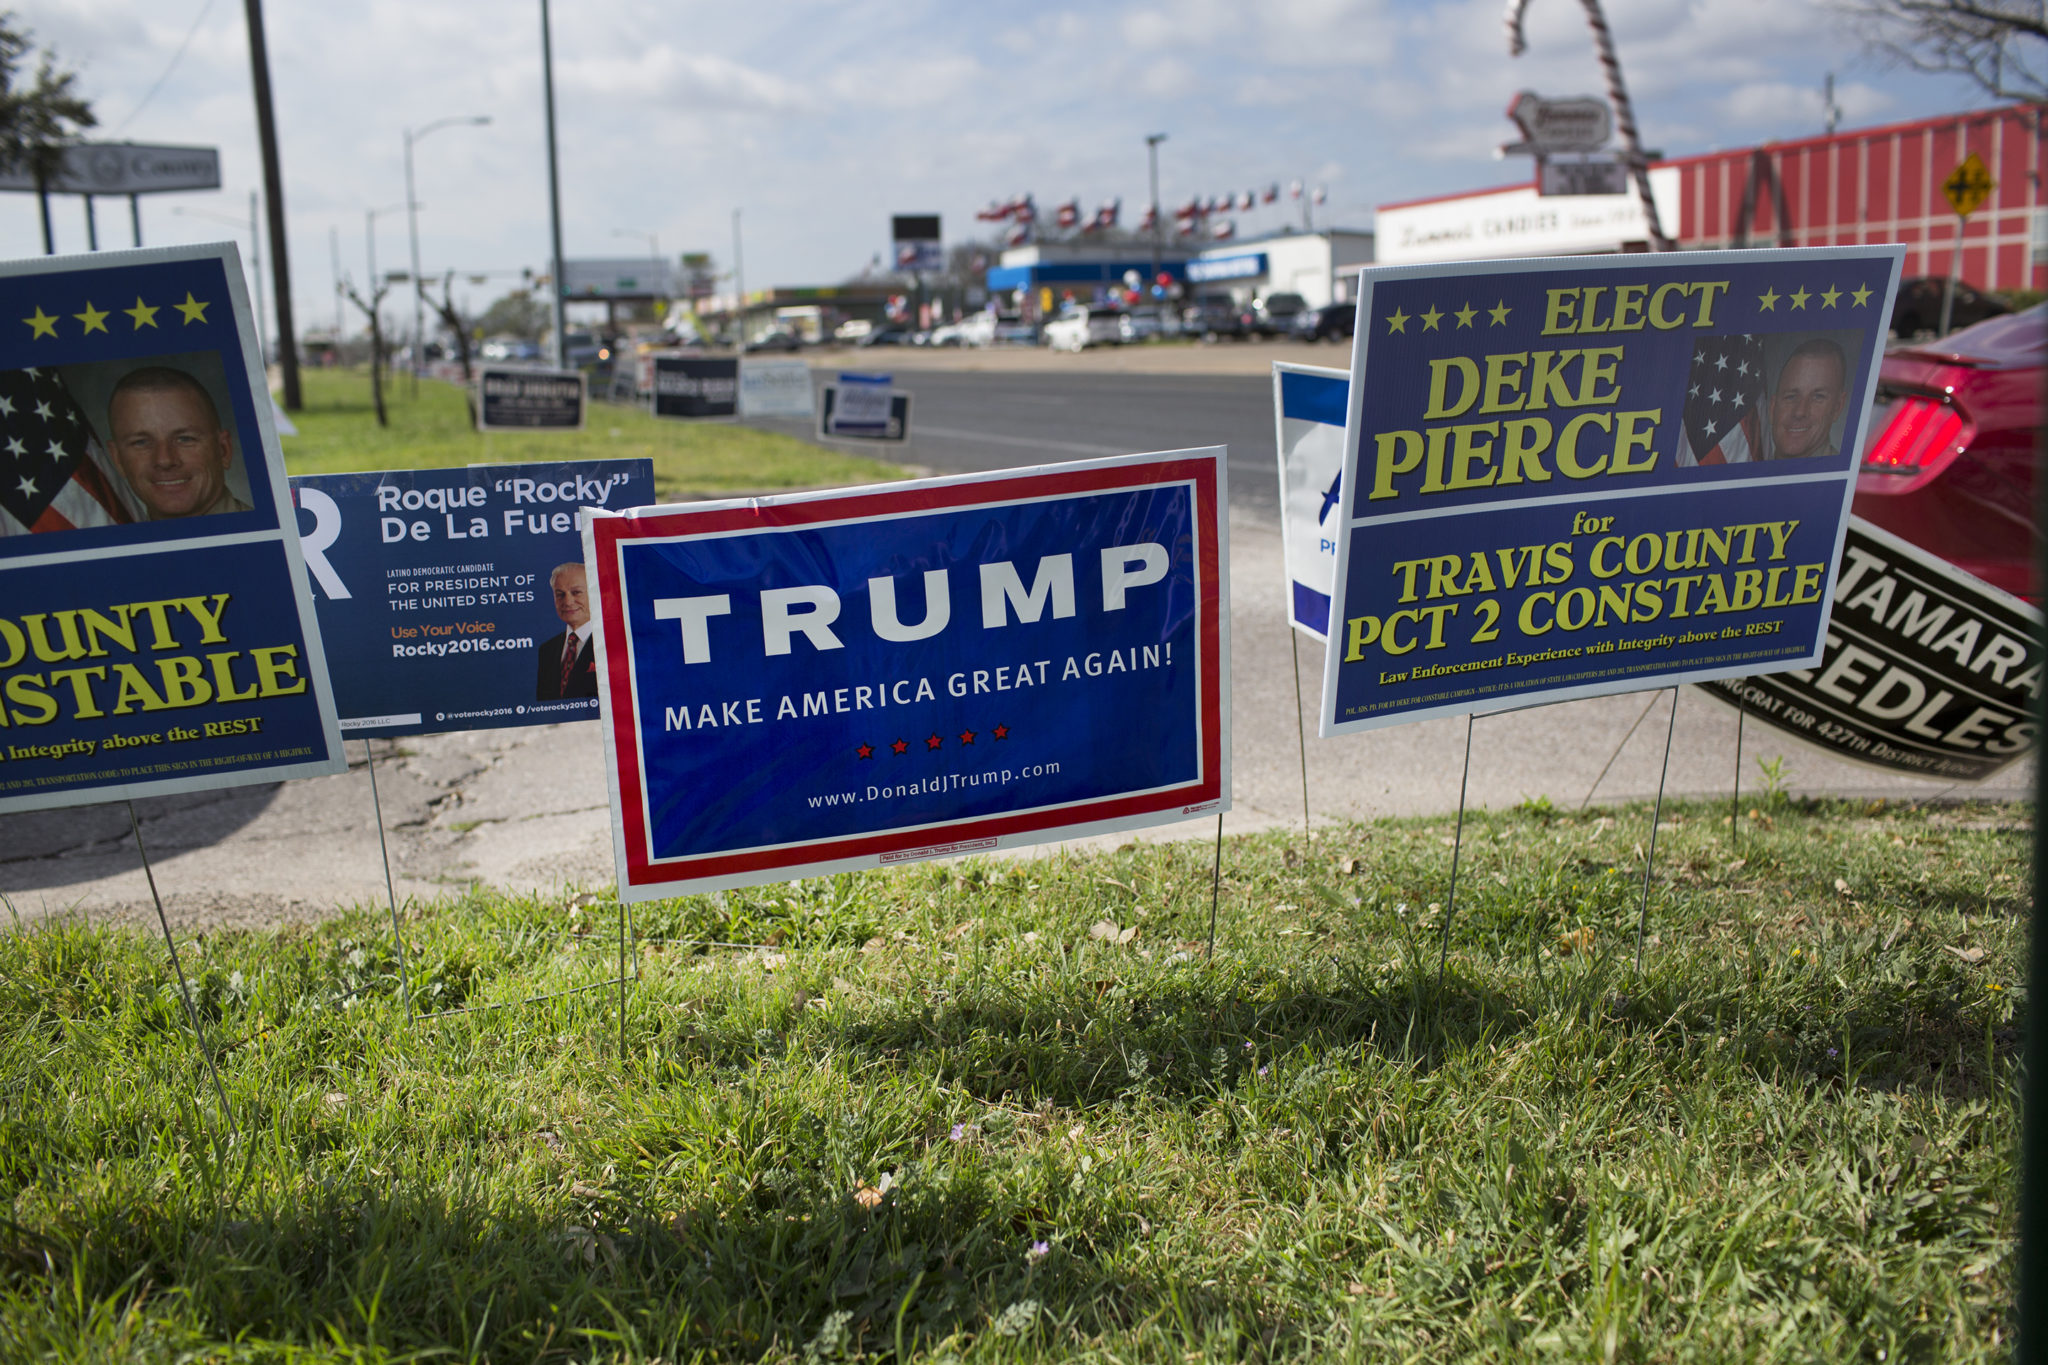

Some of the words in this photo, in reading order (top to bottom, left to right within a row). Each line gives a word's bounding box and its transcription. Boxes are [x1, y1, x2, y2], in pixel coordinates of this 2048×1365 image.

[1540, 281, 1730, 336] ELECT
[1423, 345, 1625, 420] DEKE
[1369, 408, 1662, 501] PIERCE
[378, 486, 487, 514] Roque
[1571, 511, 1614, 535] for
[381, 517, 431, 543] De
[446, 514, 489, 539] La
[386, 568, 411, 578] LATINO
[413, 565, 455, 577] DEMOCRATIC
[457, 563, 495, 574] CANDIDATE
[388, 582, 420, 595] FOR
[425, 576, 510, 592] PRESIDENT
[515, 574, 536, 586] OF
[1392, 541, 1574, 604] TRAVIS
[1589, 520, 1800, 579] COUNTY
[389, 600, 418, 611] THE
[422, 595, 476, 609] UNITED
[480, 591, 535, 605] STATES
[653, 542, 1170, 665] TRUMP
[1344, 603, 1459, 663] PCT
[1471, 599, 1501, 644] 2
[1518, 562, 1826, 636] CONSTABLE
[1833, 545, 2044, 700] TAMARA
[0, 593, 230, 669] UNTY
[391, 626, 419, 639] Use
[420, 624, 454, 637] Your
[456, 620, 496, 634] Voice
[392, 636, 534, 658] Rocky2016.com
[1379, 672, 1409, 685] Law
[1411, 655, 1503, 680] Enforcement
[1506, 645, 1582, 668] Experience
[1586, 641, 1615, 655] with
[1618, 633, 1677, 652] Integrity
[1678, 630, 1718, 644] above
[1721, 626, 1743, 639] the
[1745, 620, 1784, 637] REST
[0, 644, 306, 728] STABLE
[664, 698, 764, 732] MAKE
[776, 677, 936, 721] AMERICA
[948, 660, 1051, 698] GREAT
[1061, 642, 1174, 682] AGAIN!
[1715, 678, 1785, 713] MOCRAT
[1783, 704, 1816, 730] FOR
[1788, 631, 2042, 755] EDLES
[8, 738, 96, 759] Integrity
[102, 733, 162, 750] above
[167, 726, 200, 742] the
[203, 717, 262, 737] REST
[341, 721, 361, 730] Rocky
[808, 759, 1062, 809] www.DonaldJTrump.com
